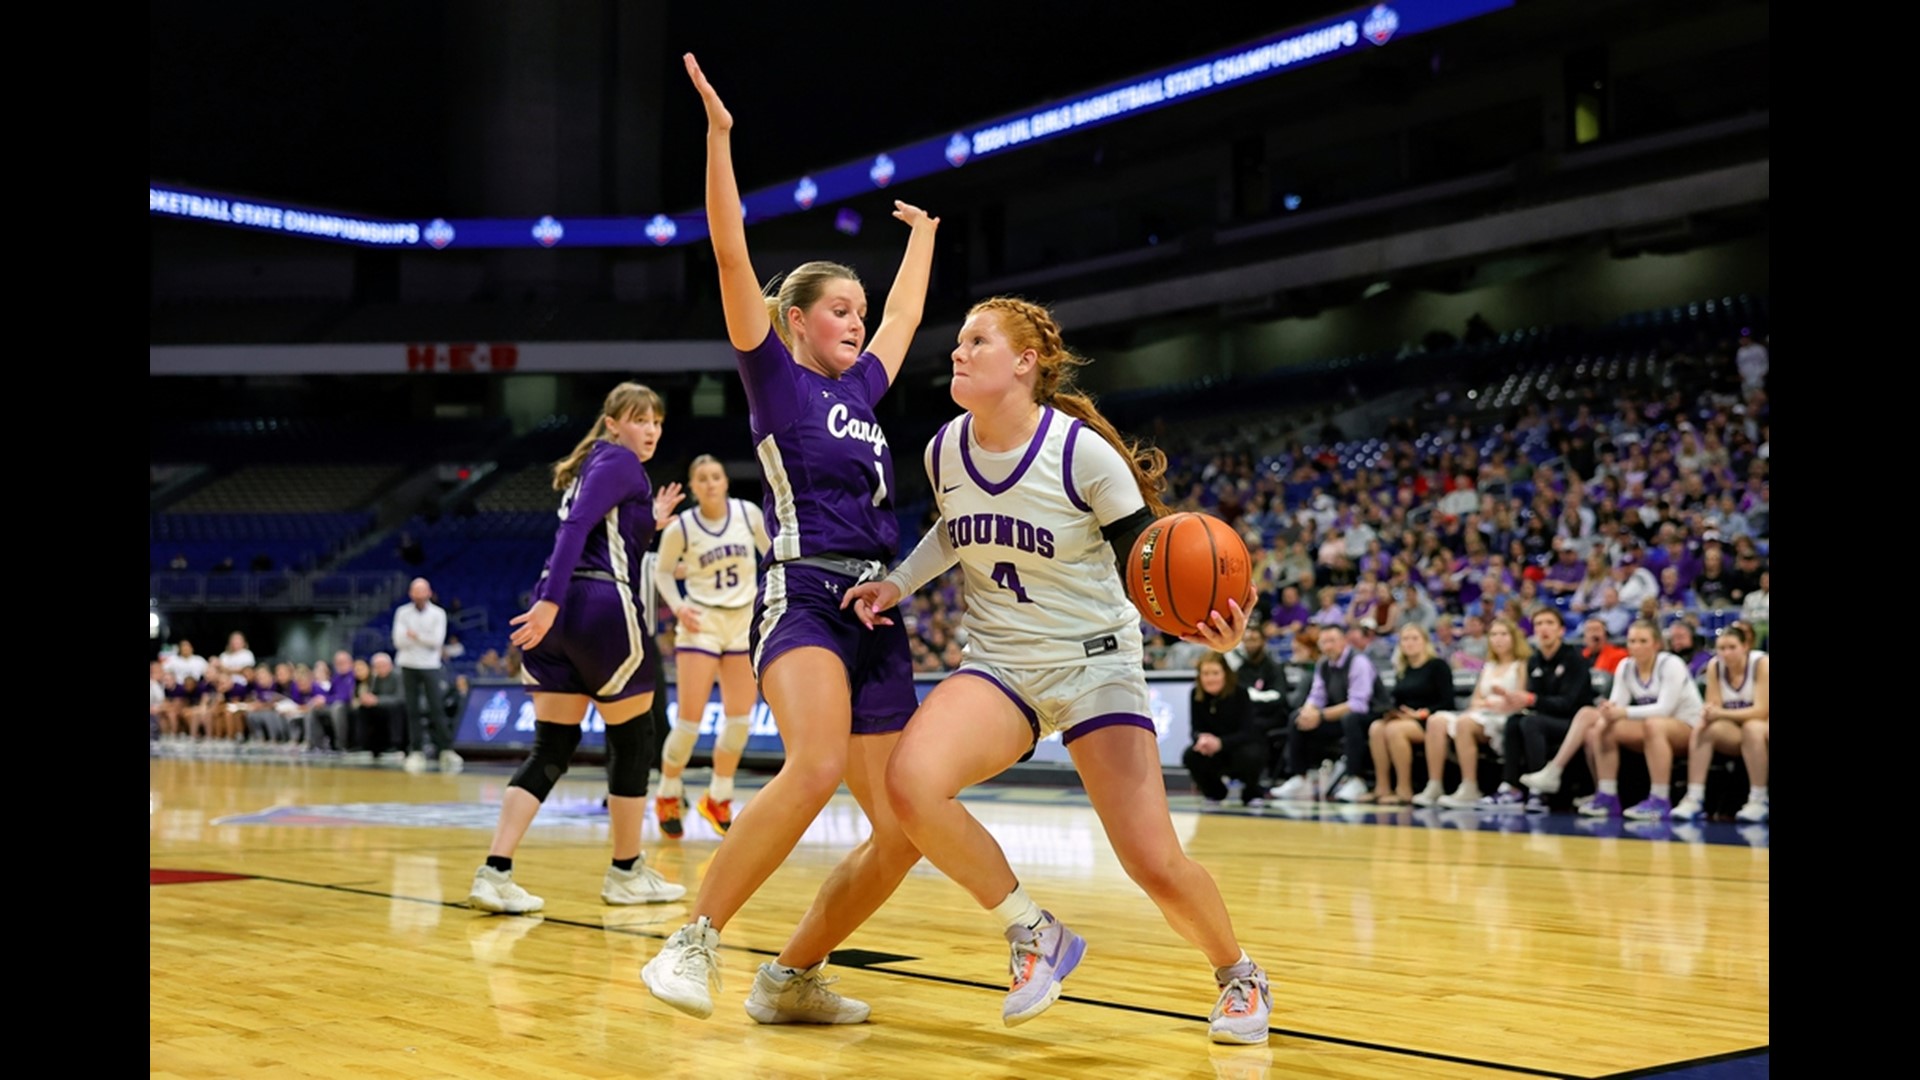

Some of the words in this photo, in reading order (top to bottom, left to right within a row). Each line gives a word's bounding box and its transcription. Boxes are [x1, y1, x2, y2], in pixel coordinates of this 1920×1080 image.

[1031, 104, 1071, 138] GIRLS
[1071, 78, 1164, 126] BASKETBALL
[1163, 63, 1213, 98] STATE
[1213, 20, 1358, 84] CHAMPIONSHIPS
[231, 202, 283, 229] STATE
[283, 209, 420, 244] CHAMPIONSHIPS
[827, 402, 889, 457] Cany
[699, 544, 749, 569] HOUNDS
[947, 513, 1055, 559] HOUNDS
[715, 564, 739, 590] 15
[990, 561, 1034, 603] 4
